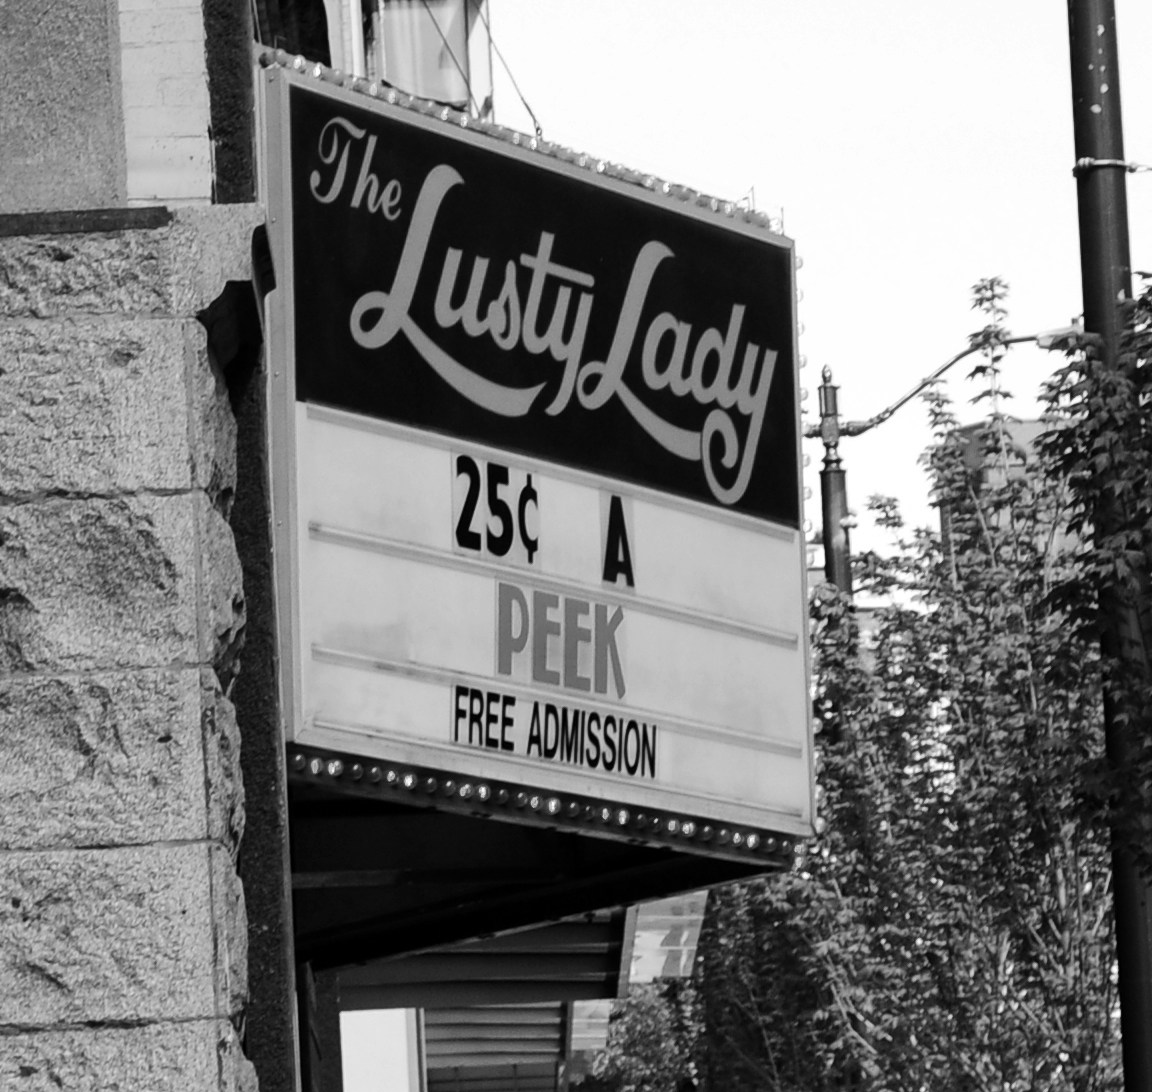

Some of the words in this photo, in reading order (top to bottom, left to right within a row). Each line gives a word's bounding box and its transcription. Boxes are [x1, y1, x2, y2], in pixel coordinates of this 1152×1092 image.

[309, 115, 402, 220] The
[350, 164, 595, 417] Lusty
[576, 240, 778, 505] Lady
[455, 455, 539, 564] 25¢
[602, 495, 635, 588] A
[498, 582, 626, 699] PEEK
[454, 685, 515, 751] FREE
[527, 701, 657, 778] ADMISSION
